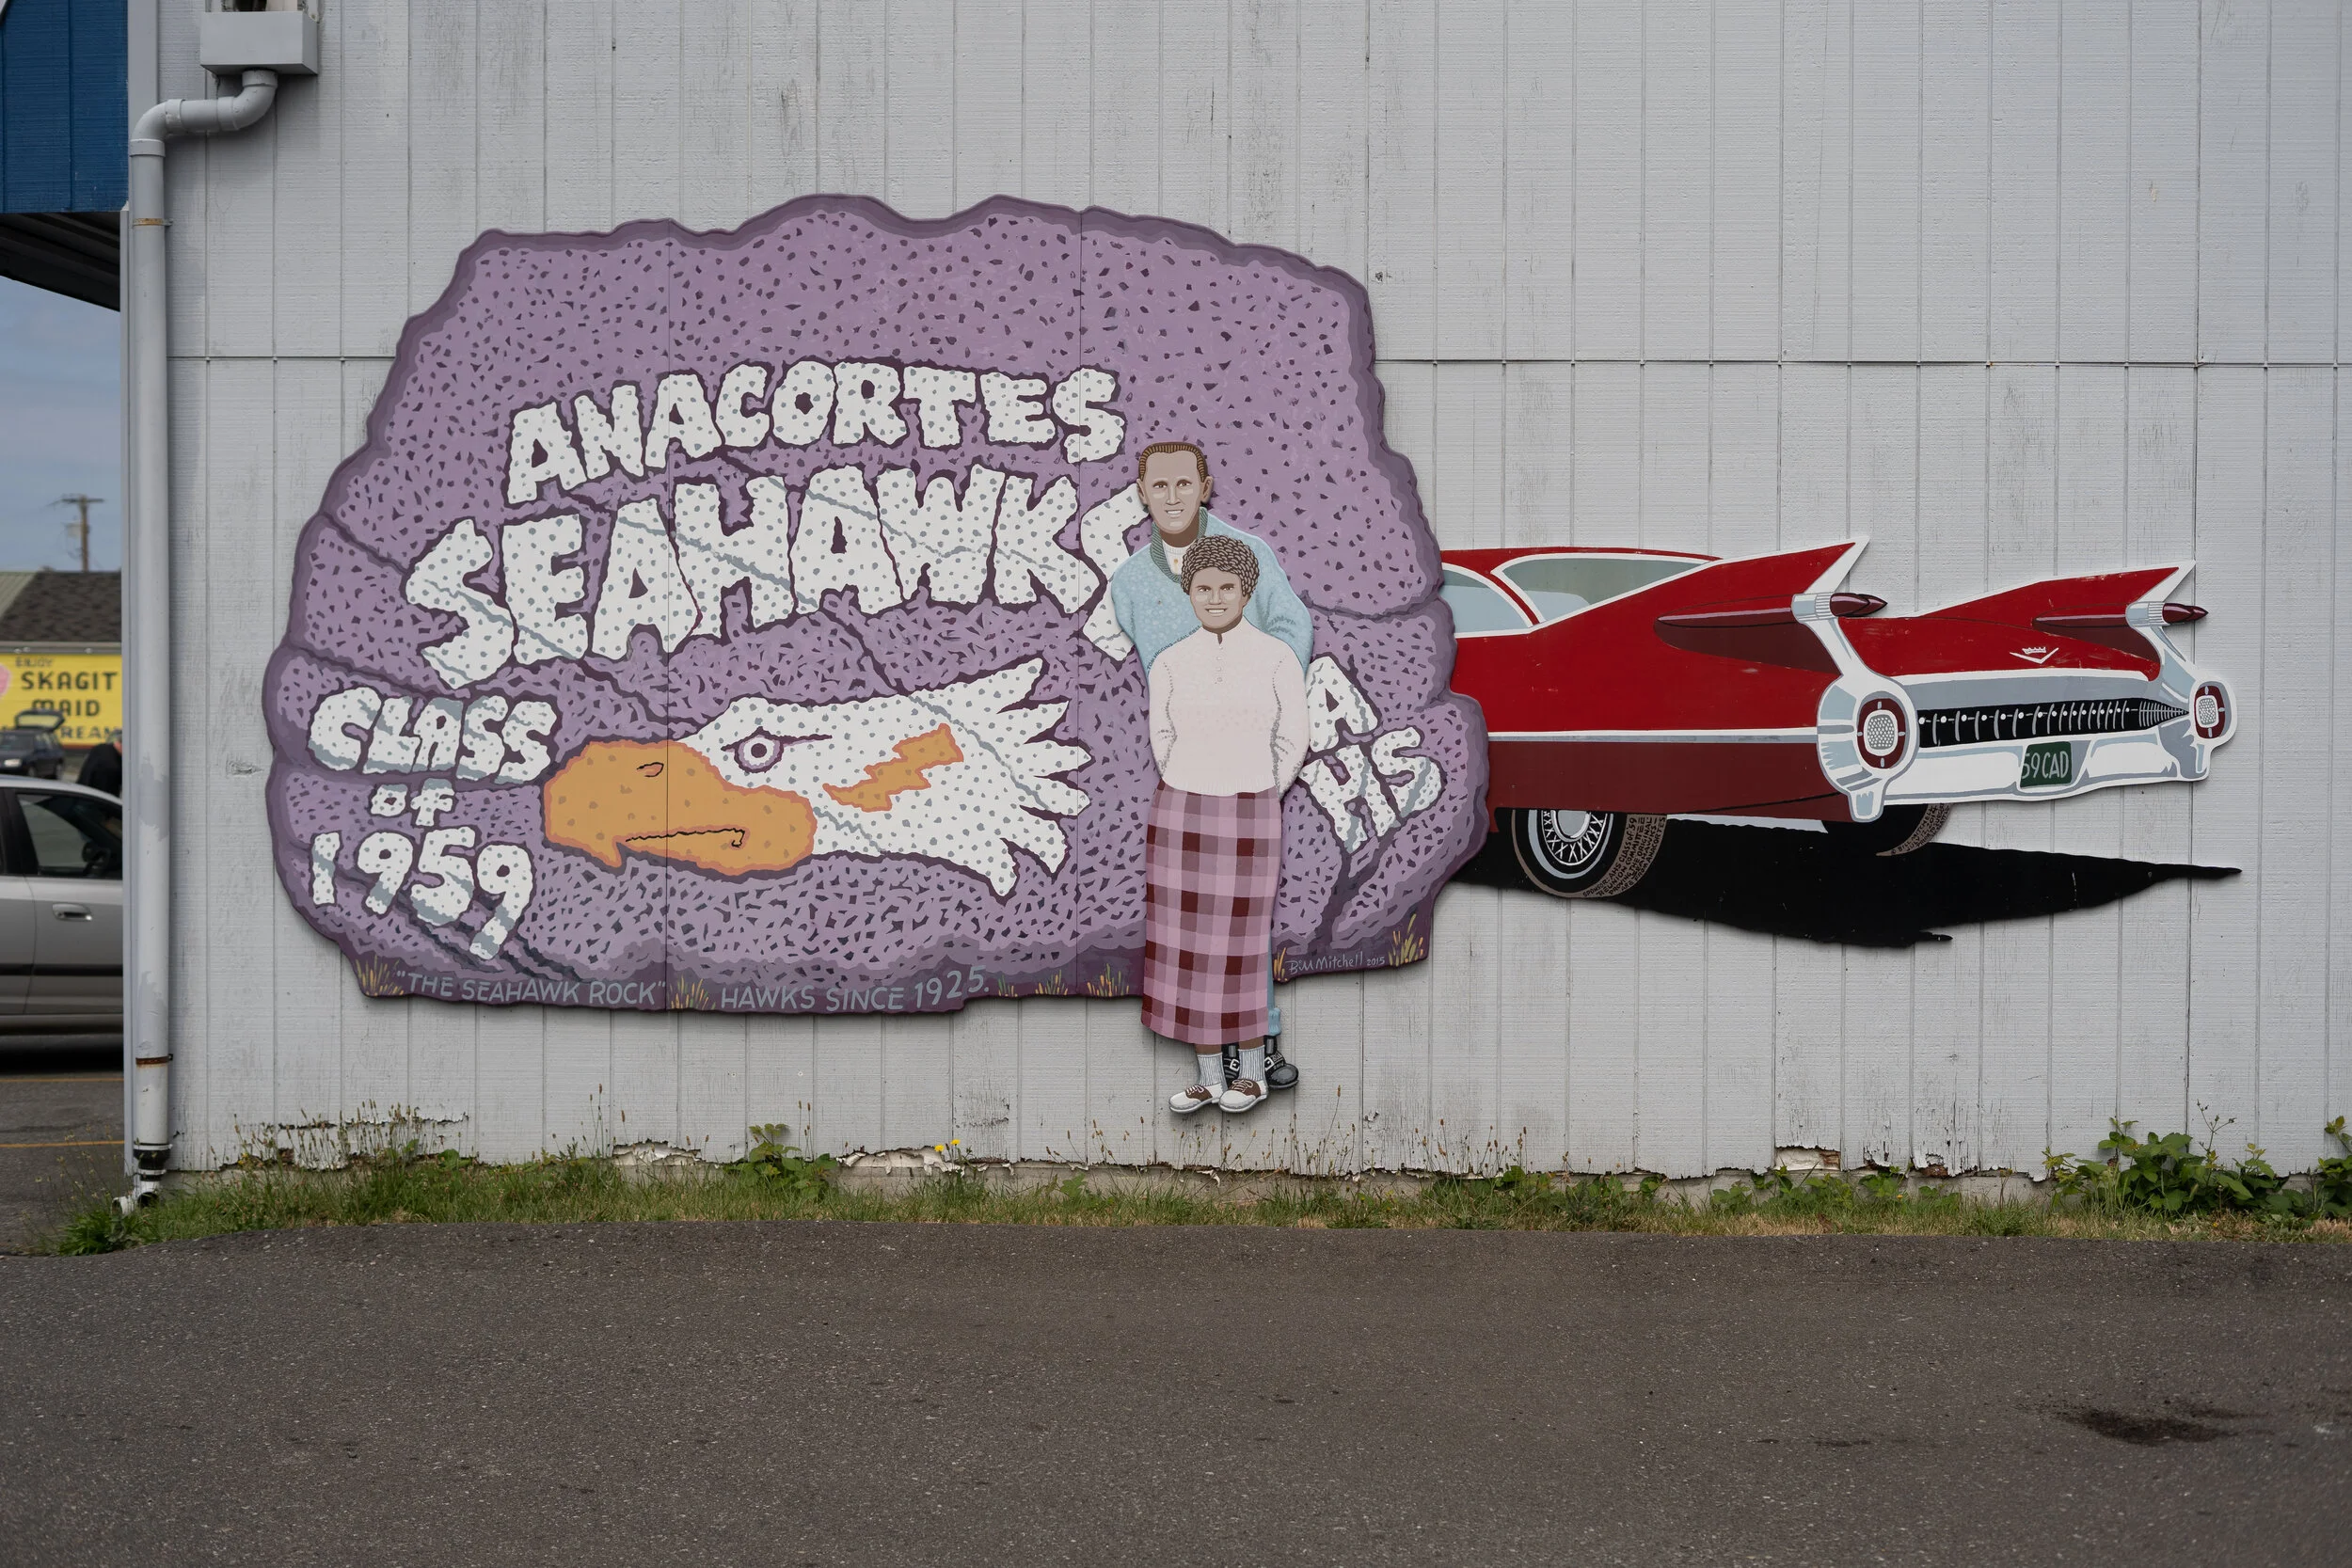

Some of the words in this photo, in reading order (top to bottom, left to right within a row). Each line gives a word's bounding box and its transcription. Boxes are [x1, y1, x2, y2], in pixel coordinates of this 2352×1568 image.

[508, 360, 1126, 503] ANACORTES
[21, 671, 118, 690] SKAGIT
[32, 699, 101, 717] MAID
[308, 686, 558, 784] CLASS
[1596, 866, 1628, 896] REUNION
[1626, 816, 1645, 865] COMMITTEE
[1646, 816, 1666, 863] ANACORTES
[1609, 863, 1622, 879] AHS
[1619, 841, 1632, 863] CLASS
[310, 826, 535, 959] 1959
[1315, 951, 1363, 971] Mitchell
[1366, 957, 1385, 967] 2015
[461, 977, 580, 1004] SEAHAWK
[721, 984, 817, 1010] HAWKS
[825, 986, 905, 1012] SINCE
